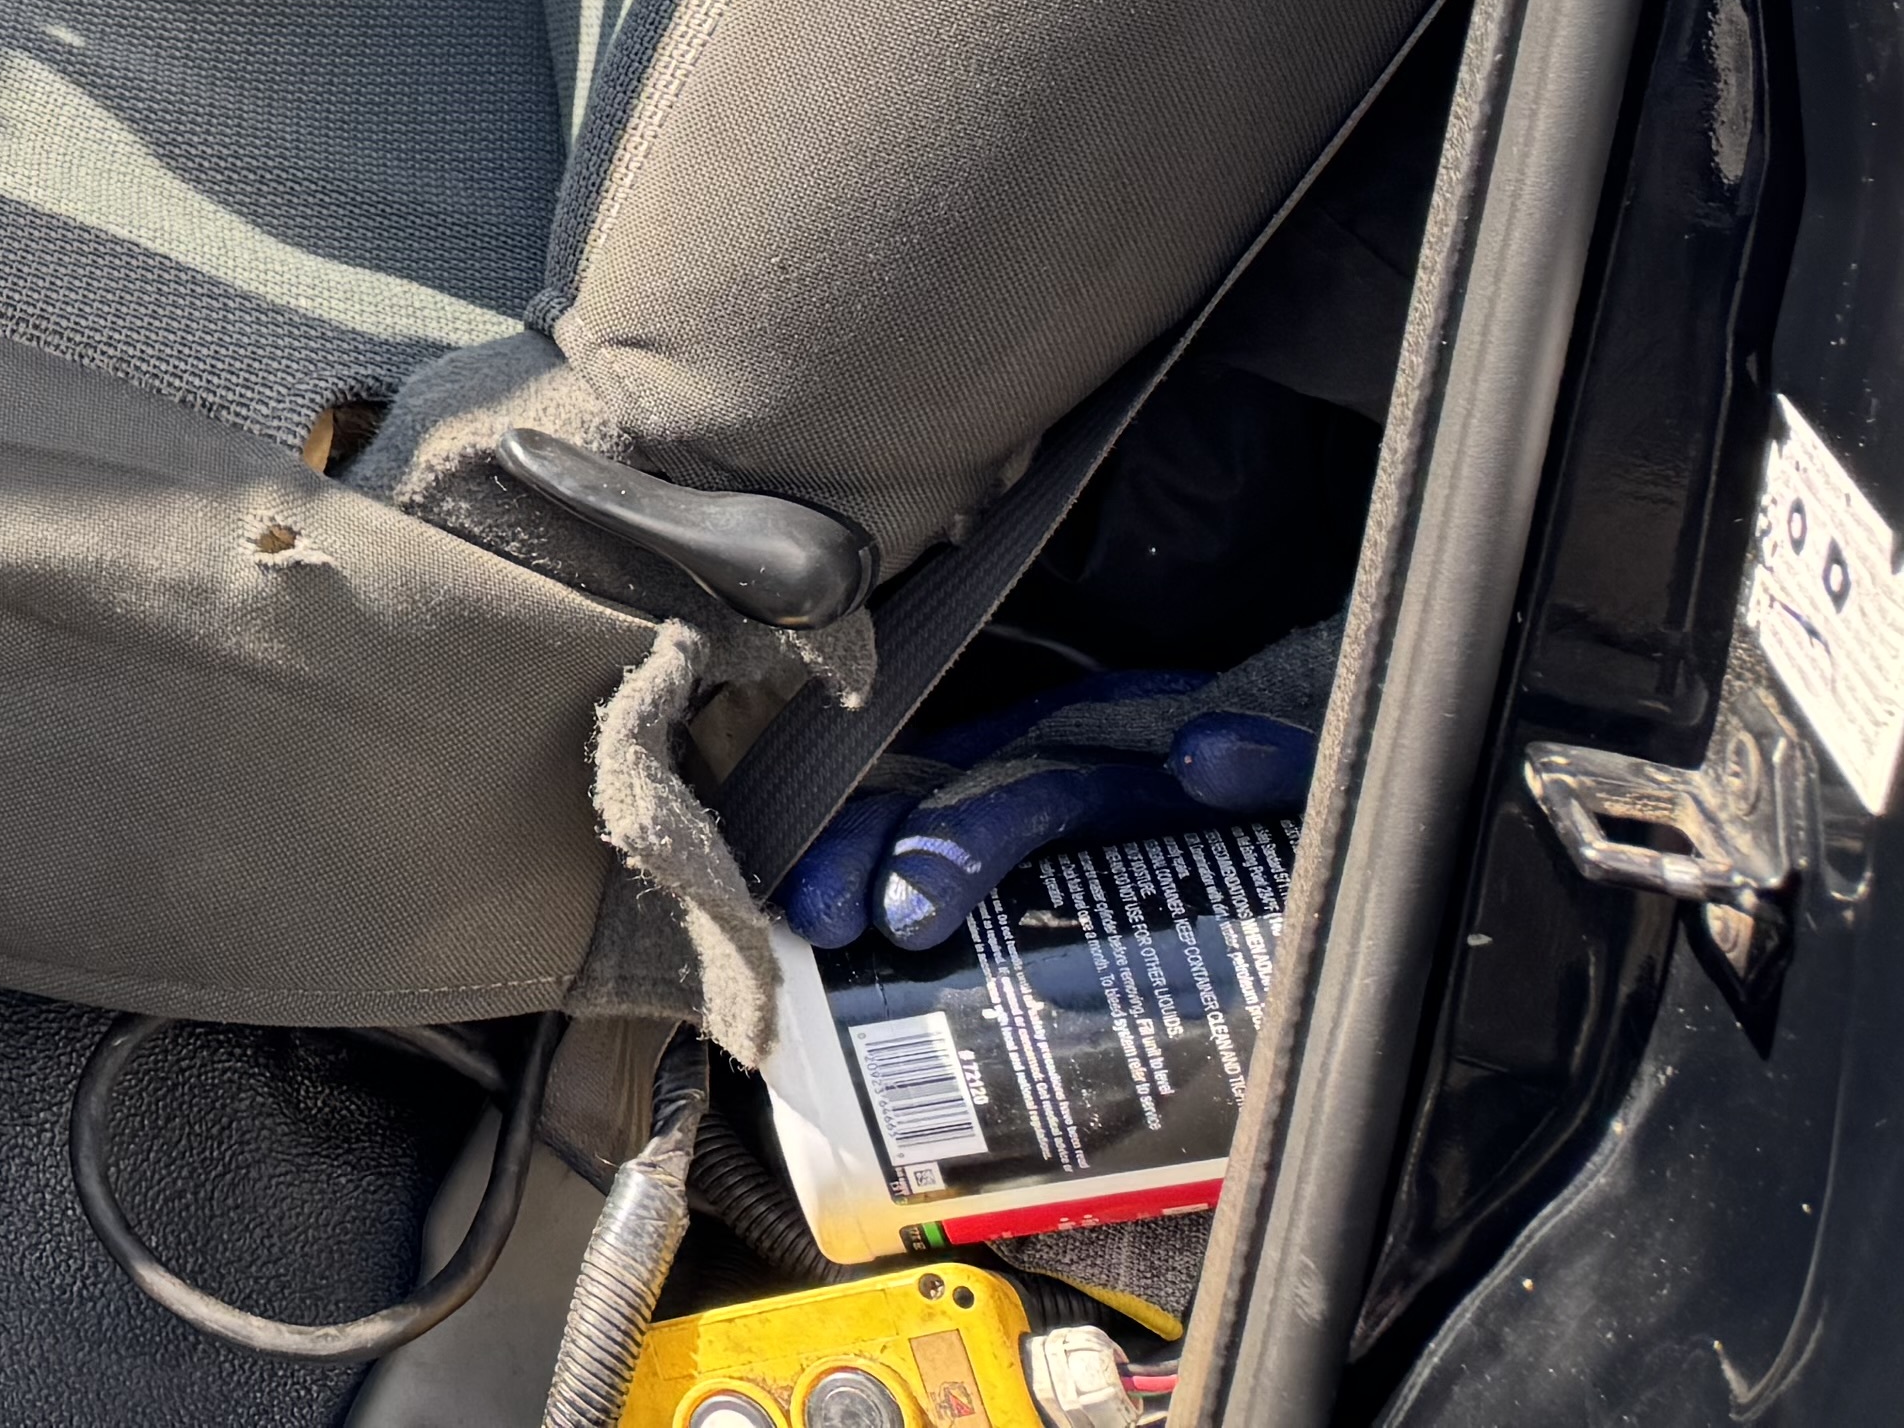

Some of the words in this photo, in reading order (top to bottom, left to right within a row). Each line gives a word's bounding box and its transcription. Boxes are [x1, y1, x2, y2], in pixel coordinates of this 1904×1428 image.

[1072, 892, 1090, 910] level
[1117, 884, 1137, 900] NOT
[1077, 910, 1094, 931] once
[1124, 903, 1143, 923] USE
[1132, 923, 1152, 946] FOR
[1173, 918, 1196, 946] KEEP
[1240, 918, 1266, 954] WHEN
[1088, 939, 1109, 973] month.
[1107, 935, 1126, 966] before
[1099, 973, 1115, 988] To
[1140, 946, 1166, 988] OTHER
[1184, 946, 1219, 1011] CONTAINER
[1227, 951, 1258, 1004] petroleum
[1104, 987, 1126, 1018] bleed
[1118, 966, 1142, 1017] removing.
[1154, 987, 1183, 1038] LIQUIDS.
[1113, 1018, 1136, 1057] system
[1135, 1019, 1155, 1036] Fill
[1206, 1010, 1232, 1050] CLEAN
[1142, 1036, 1161, 1057] unit
[1009, 1051, 1025, 1071] and
[1016, 971, 1031, 988] until
[1038, 1041, 1065, 1101] precautions
[1059, 1101, 1073, 1125] have
[1067, 1125, 1080, 1148] been
[1075, 1150, 1089, 1169] read
[1127, 1057, 1146, 1082] refer
[1149, 1057, 1163, 1069] to
[1219, 1051, 1241, 1075] AND
[1016, 1071, 1037, 1109] national
[1036, 1082, 1049, 1099] Get
[1136, 1082, 1149, 1094] to
[1153, 1069, 1174, 1095] level
[1042, 1099, 1062, 1136] medical
[1139, 1095, 1162, 1131] service
[1054, 1137, 1069, 1163] advice
